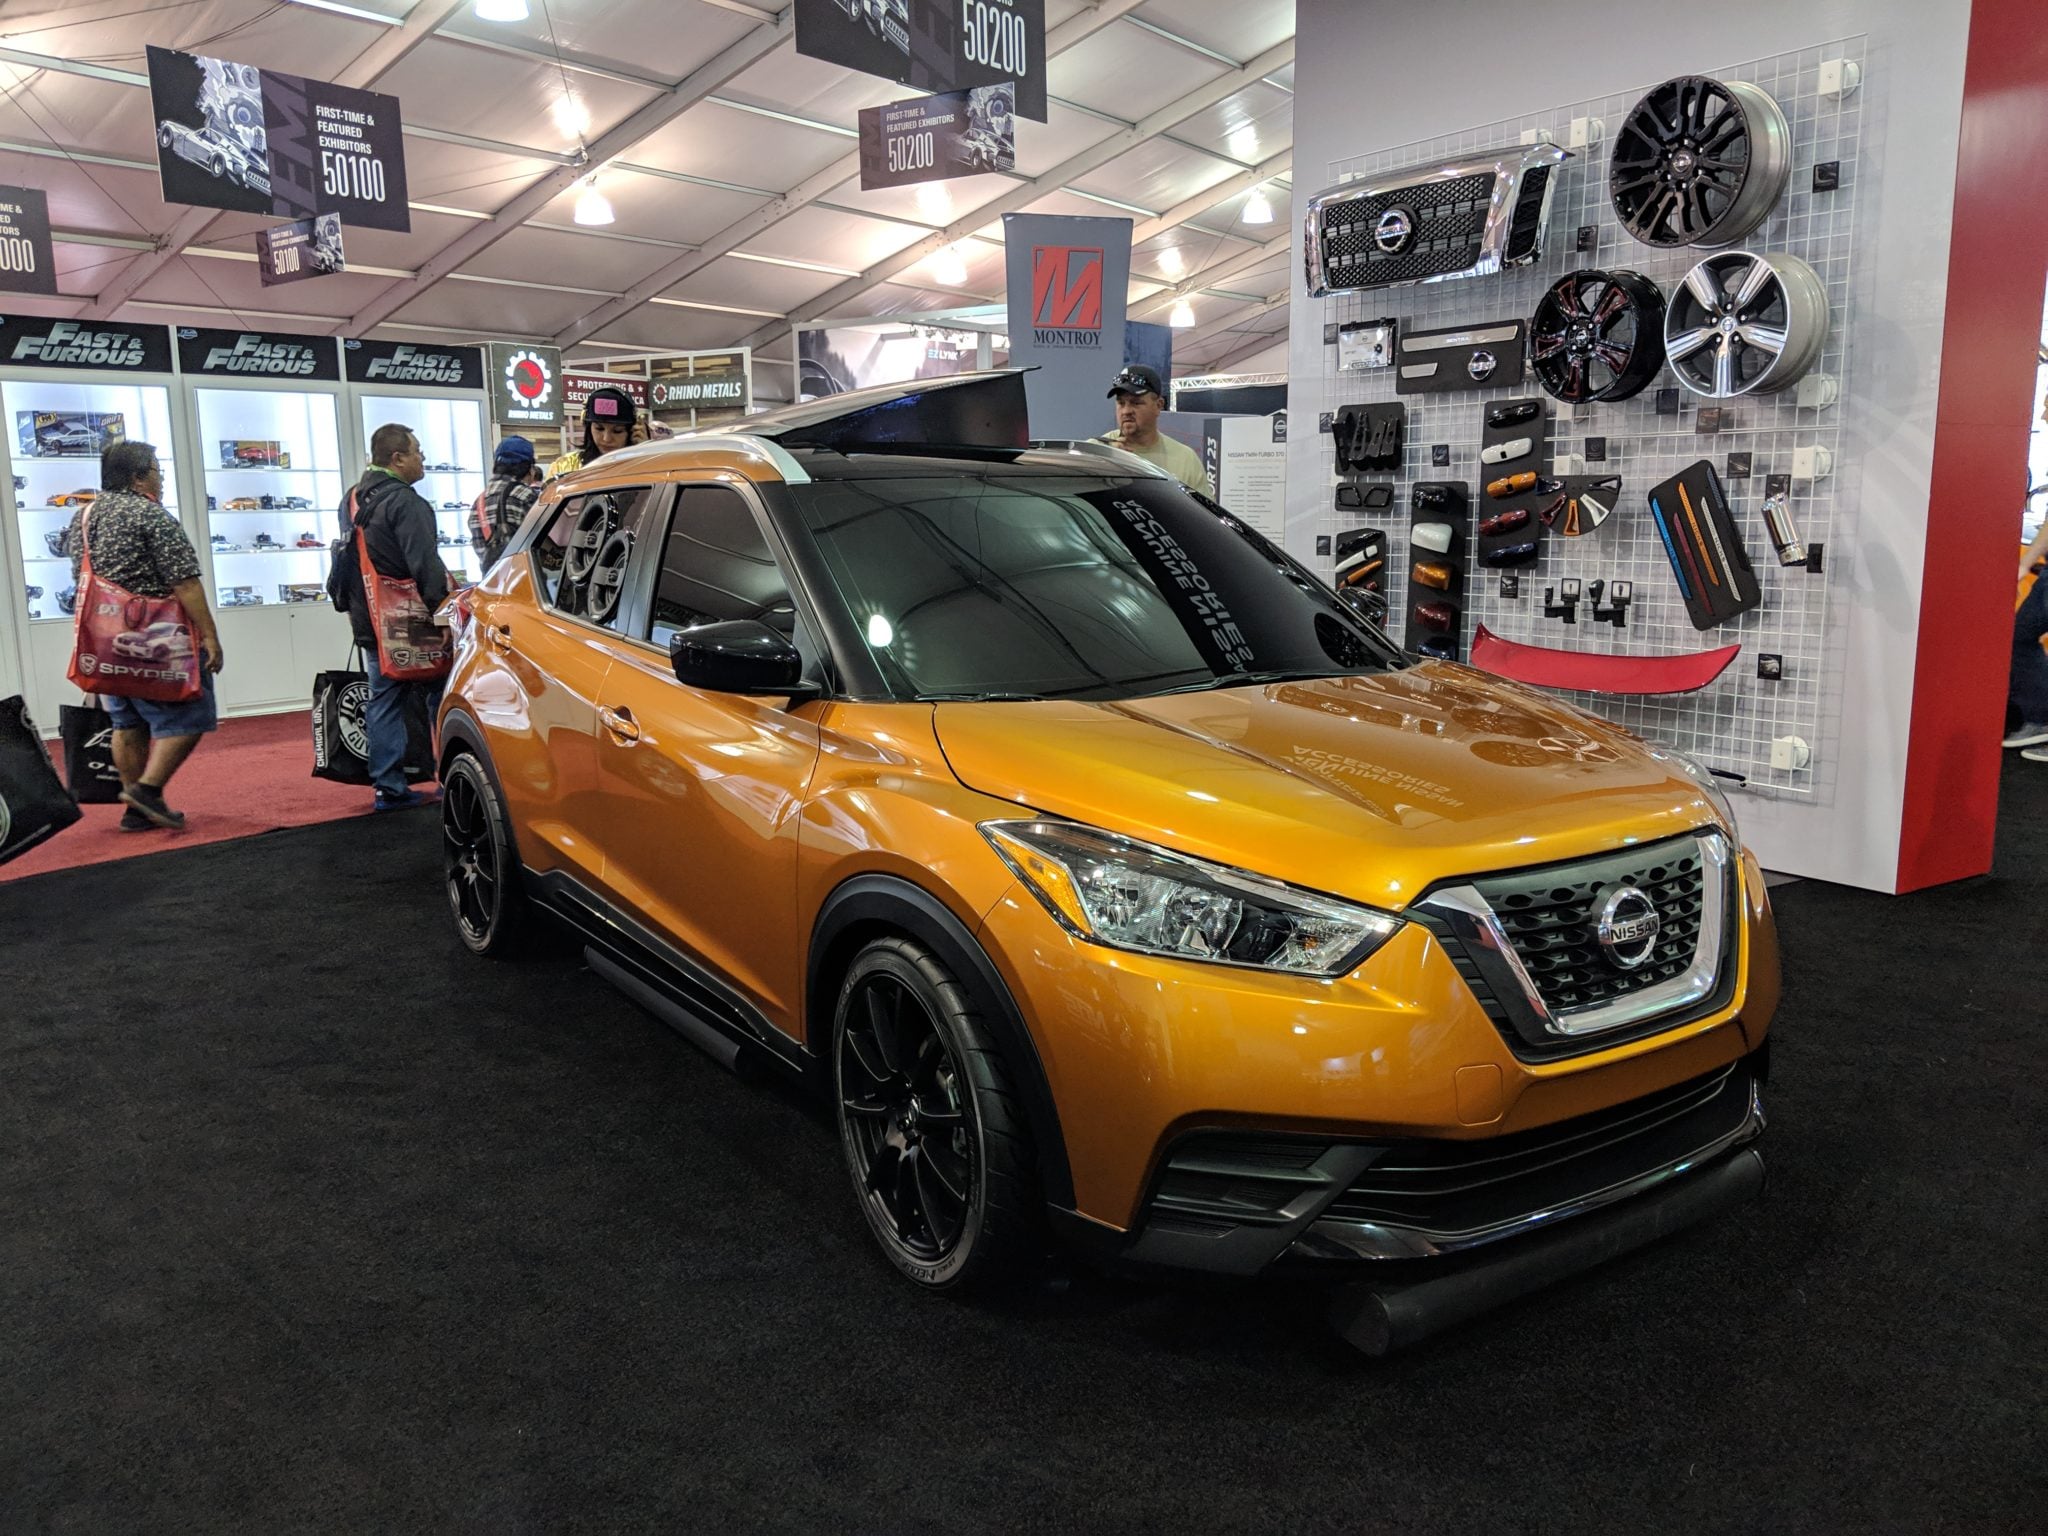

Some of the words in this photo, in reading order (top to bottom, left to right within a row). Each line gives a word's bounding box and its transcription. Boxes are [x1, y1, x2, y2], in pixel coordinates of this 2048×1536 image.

[963, 0, 1026, 77] 50200
[315, 105, 366, 125] FIRST-TIME
[367, 115, 375, 126] &
[886, 108, 919, 122] FIRST-TIME
[920, 107, 925, 115] &
[886, 120, 917, 133] FEATURED
[918, 114, 955, 128] EXHIBITORS
[317, 121, 362, 138] FEATURED
[319, 136, 372, 154] EXHIBITORS
[888, 132, 934, 172] 50200
[321, 151, 386, 202] 50100
[15, 205, 23, 214] &
[0, 236, 35, 273] 000
[273, 246, 300, 275] 50100
[46, 322, 129, 349] FAST
[128, 338, 144, 350] &
[232, 334, 303, 359] FAST
[302, 349, 315, 360] &
[1034, 330, 1101, 345] MONTROY
[11, 336, 145, 366] FURIOUS
[203, 348, 317, 374] FURIOUS
[391, 346, 452, 368] FAST
[450, 359, 462, 369] &
[939, 350, 958, 360] LYNK
[365, 357, 463, 382] FURIOUS
[668, 384, 701, 401] RHINO
[702, 382, 741, 398] METALS
[529, 411, 554, 420] METALS
[1207, 436, 1217, 460] 23
[416, 650, 451, 661] SPY
[100, 663, 190, 682] SPYDER
[314, 725, 325, 768] CHEMICAL
[1611, 920, 1659, 940] NISSAN
